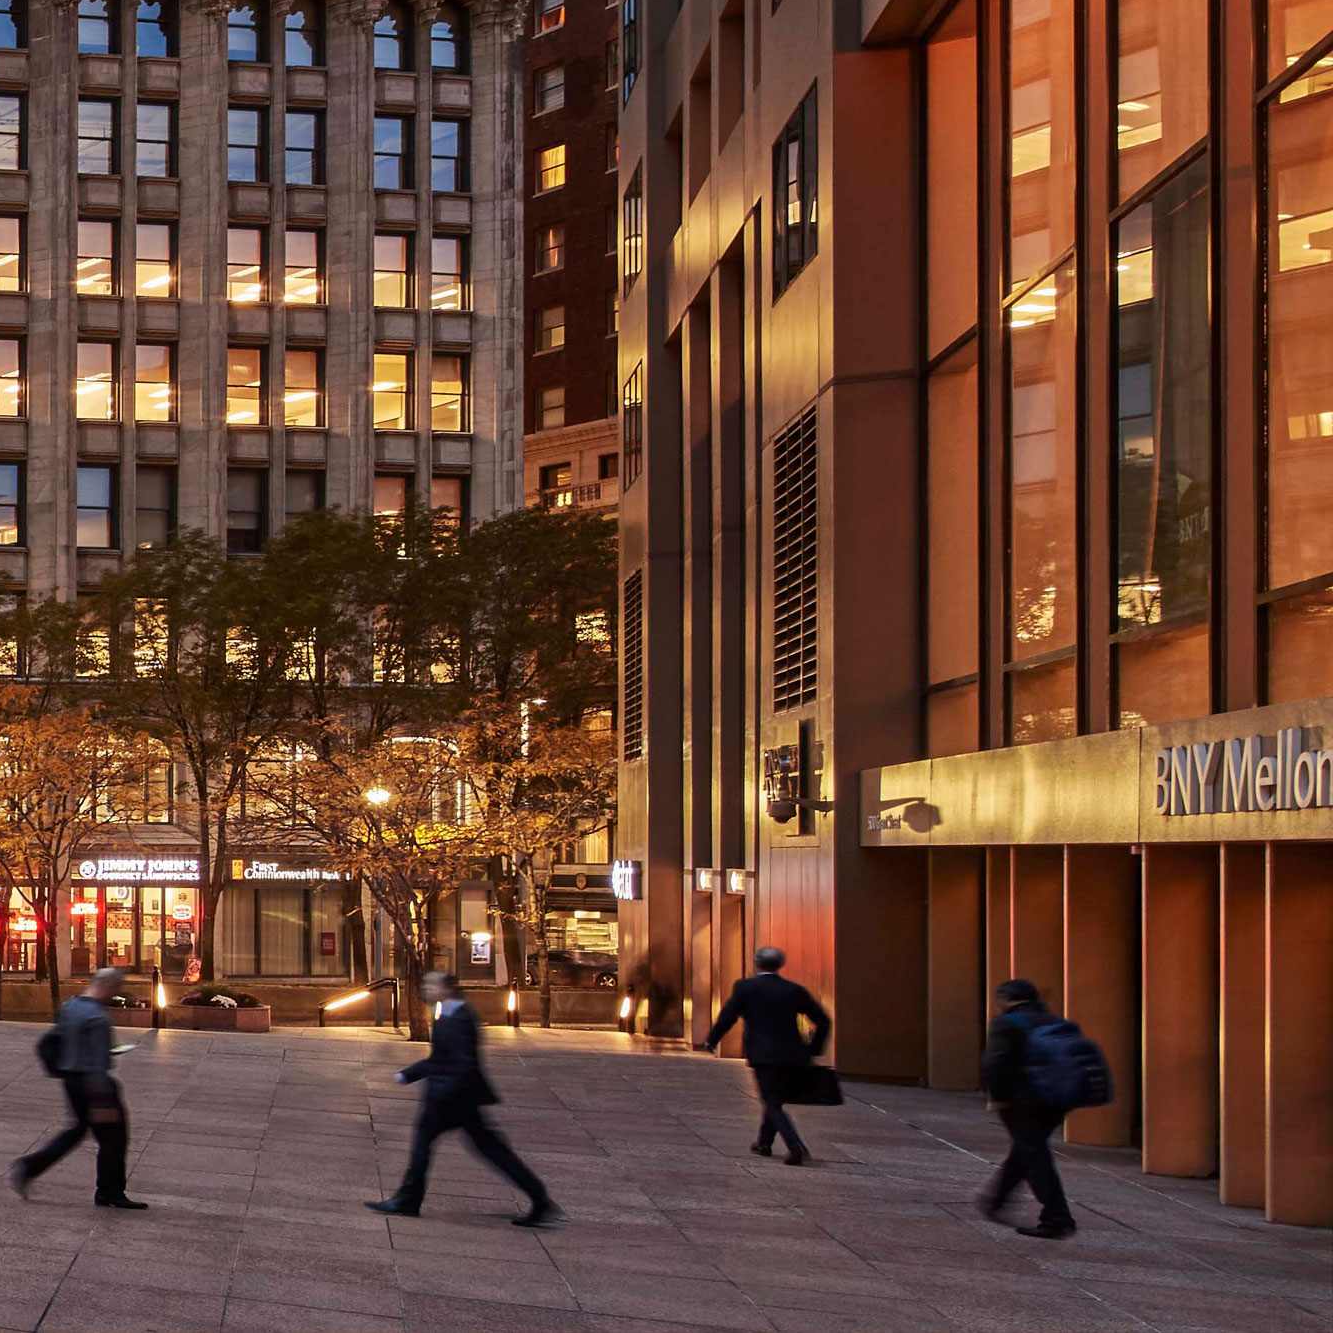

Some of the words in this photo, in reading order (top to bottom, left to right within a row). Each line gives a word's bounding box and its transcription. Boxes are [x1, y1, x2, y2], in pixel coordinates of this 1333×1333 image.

[1155, 740, 1222, 816] BNY
[1222, 727, 1333, 813] Mellon
[97, 859, 147, 874] JIMMY
